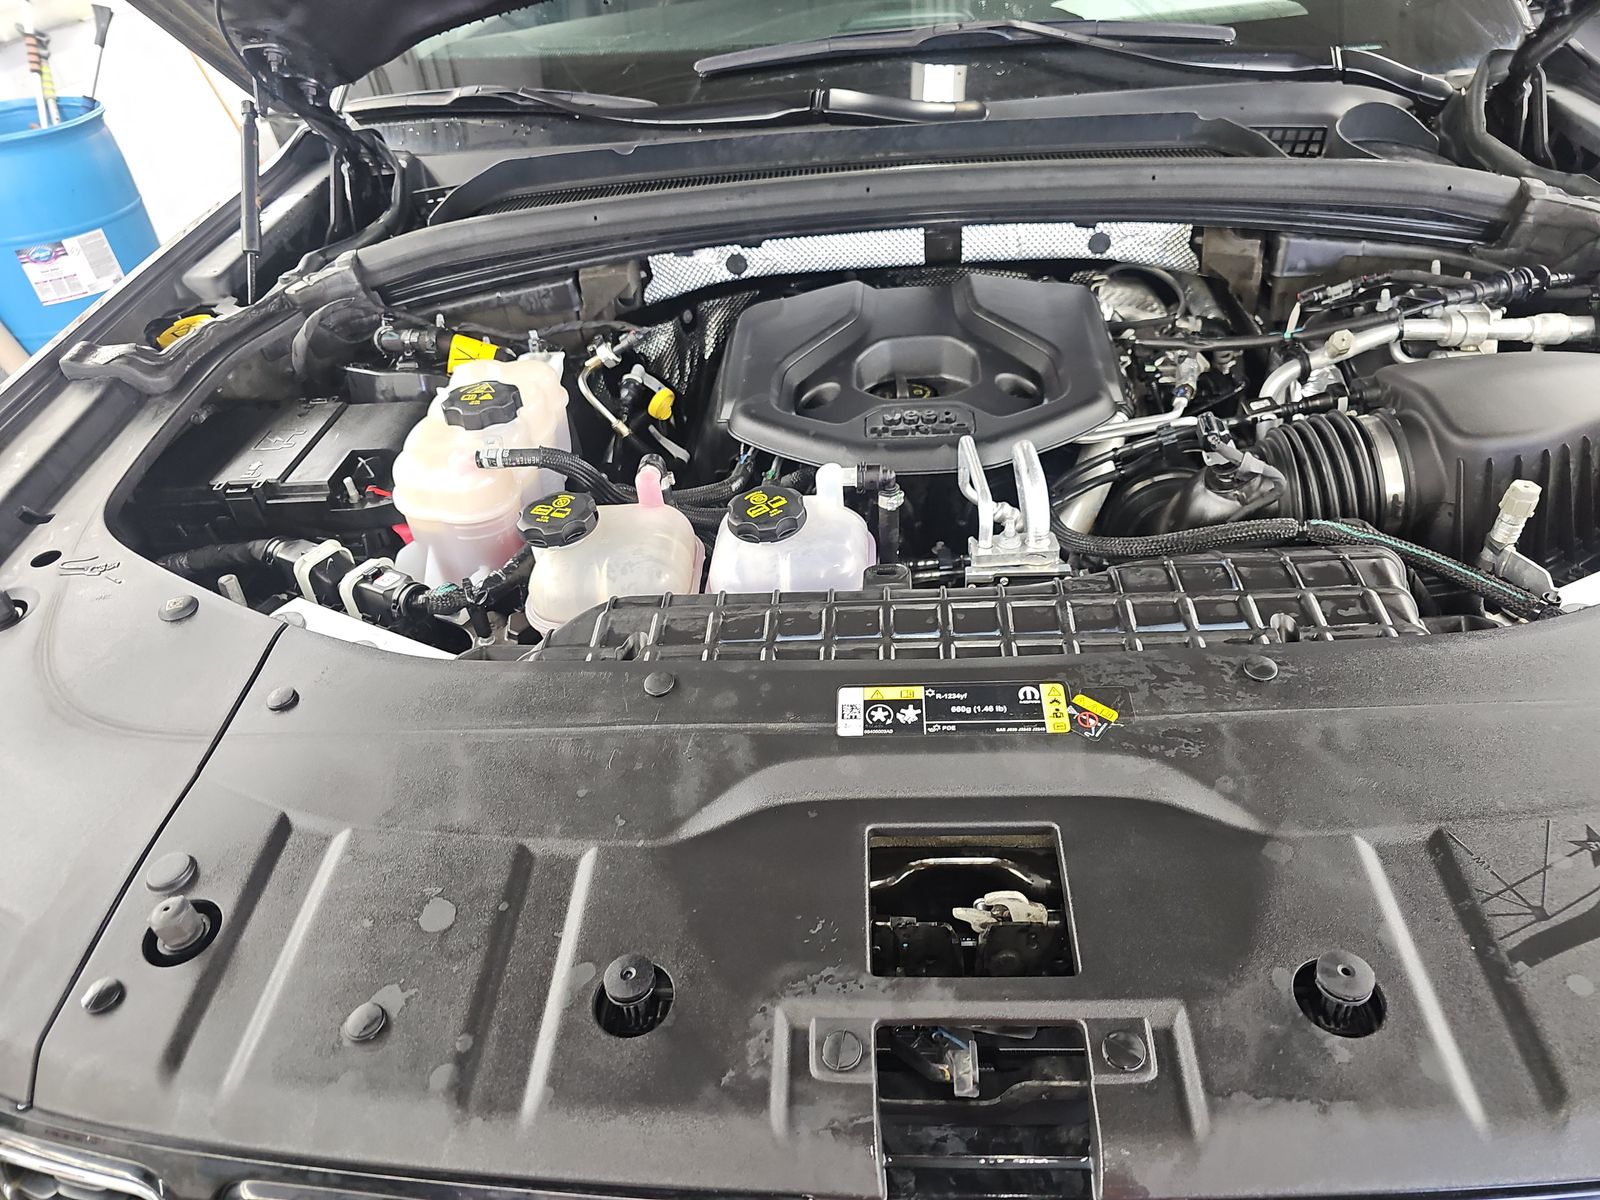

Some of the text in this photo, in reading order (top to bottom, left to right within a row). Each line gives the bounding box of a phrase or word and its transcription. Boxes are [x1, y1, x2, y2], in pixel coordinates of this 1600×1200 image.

[515, 456, 541, 465] HEATER
[936, 692, 968, 701] R-1234yf
[995, 705, 1008, 714] lb)
